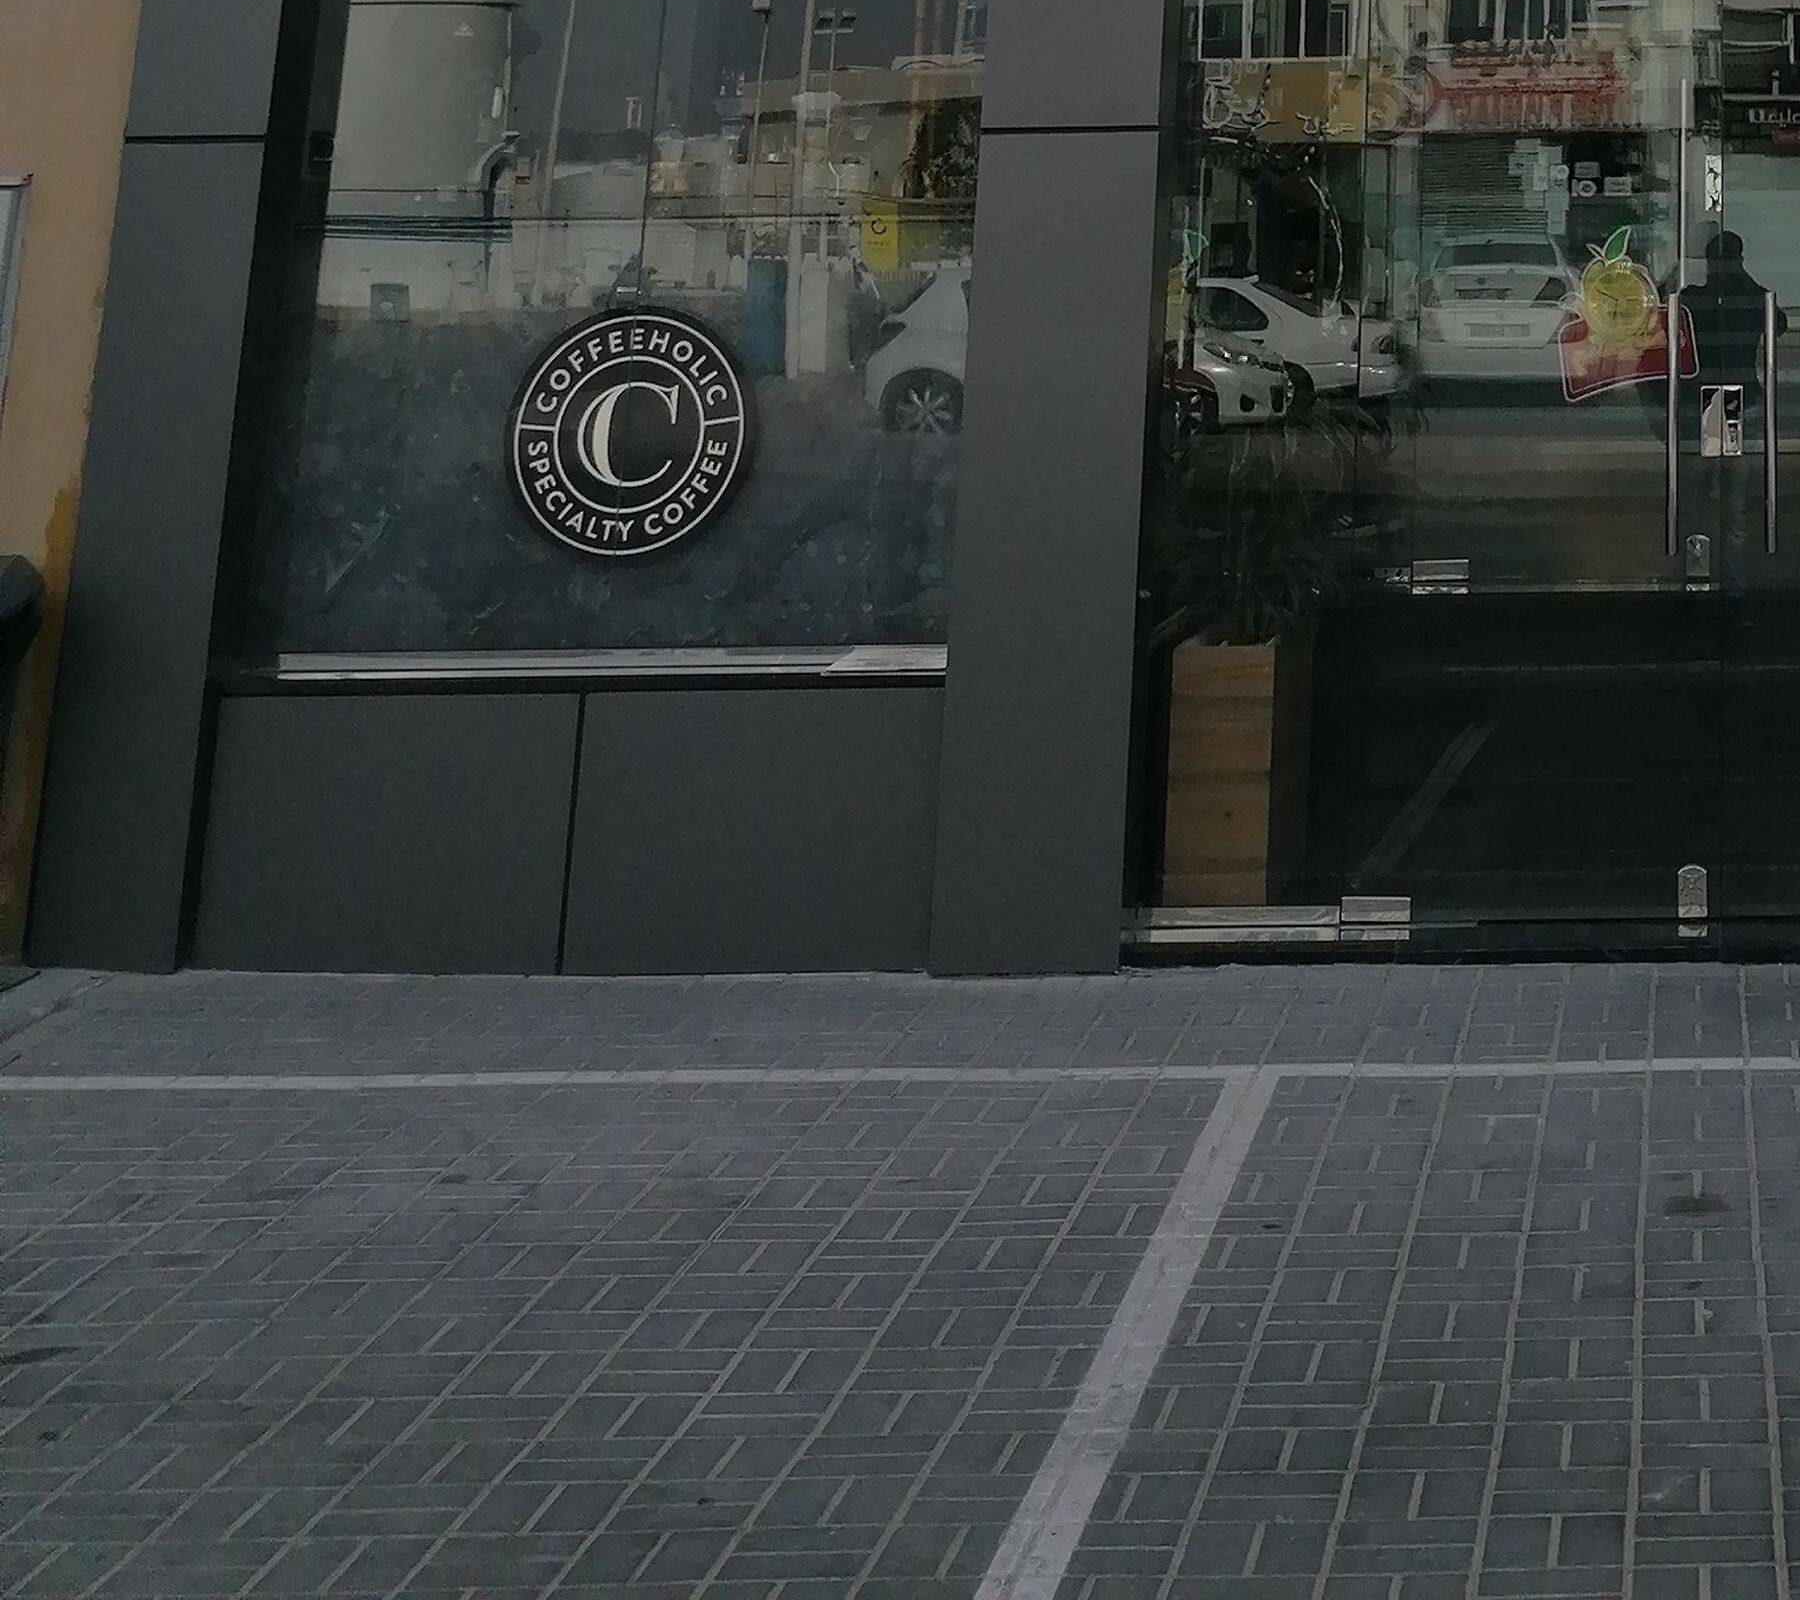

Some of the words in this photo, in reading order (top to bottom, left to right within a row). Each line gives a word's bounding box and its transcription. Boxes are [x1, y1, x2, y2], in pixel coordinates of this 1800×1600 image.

[536, 328, 728, 413] COFFEEHOLIC
[577, 381, 679, 488] C
[527, 440, 635, 542] SPECIALTY
[644, 439, 728, 536] COFFEE
